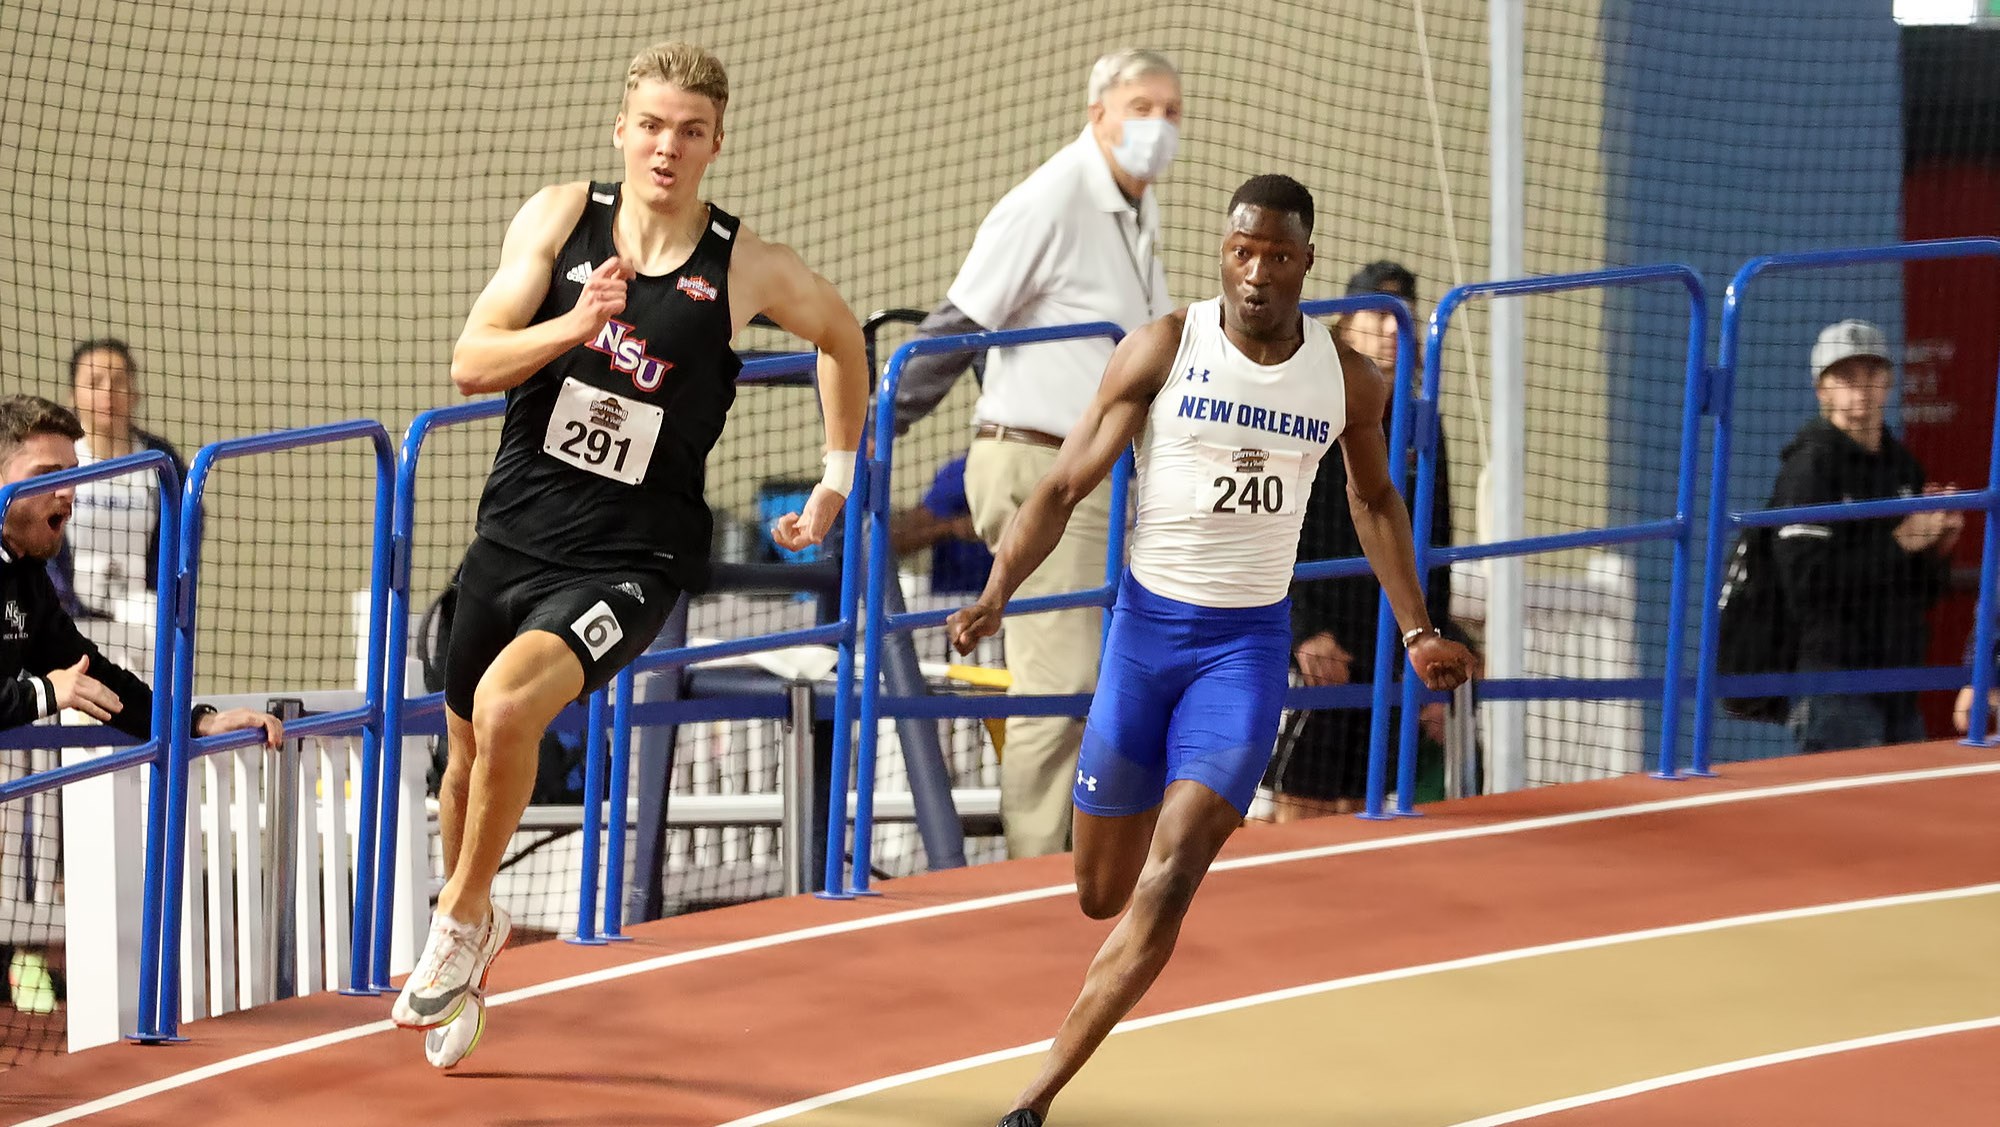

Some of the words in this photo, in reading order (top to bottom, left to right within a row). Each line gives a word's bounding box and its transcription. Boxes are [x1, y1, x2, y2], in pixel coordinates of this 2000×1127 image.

[588, 319, 670, 391] NSU
[1178, 395, 1234, 424] NEW
[1236, 403, 1330, 444] ORLEANS
[559, 420, 632, 473] 291
[1212, 475, 1283, 514] 240
[5, 600, 27, 631] NSU
[583, 614, 618, 648] 6
